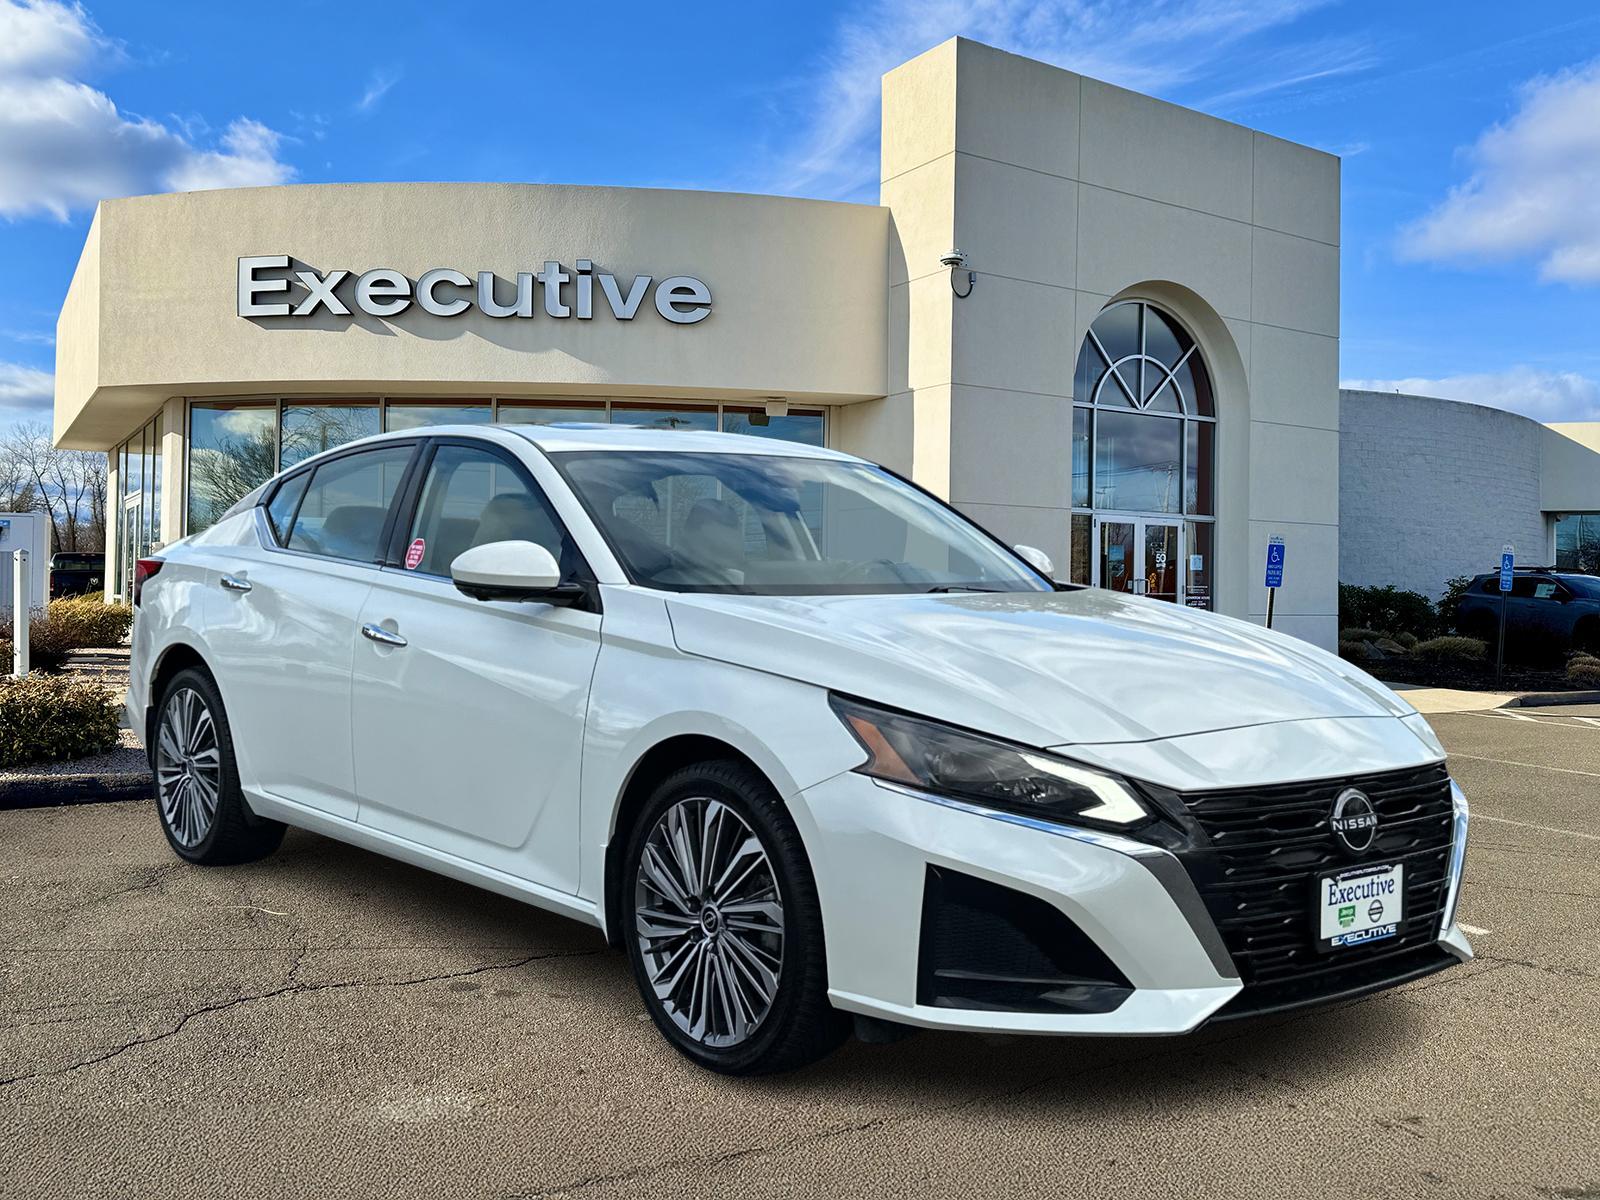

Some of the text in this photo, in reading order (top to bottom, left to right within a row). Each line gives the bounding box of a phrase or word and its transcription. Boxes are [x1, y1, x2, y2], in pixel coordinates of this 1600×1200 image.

[237, 255, 713, 324] Executive
[1156, 553, 1166, 563] 50
[1332, 814, 1378, 831] NISSAN
[1328, 876, 1395, 906] Executive
[1331, 923, 1397, 947] EXECUTIVE
